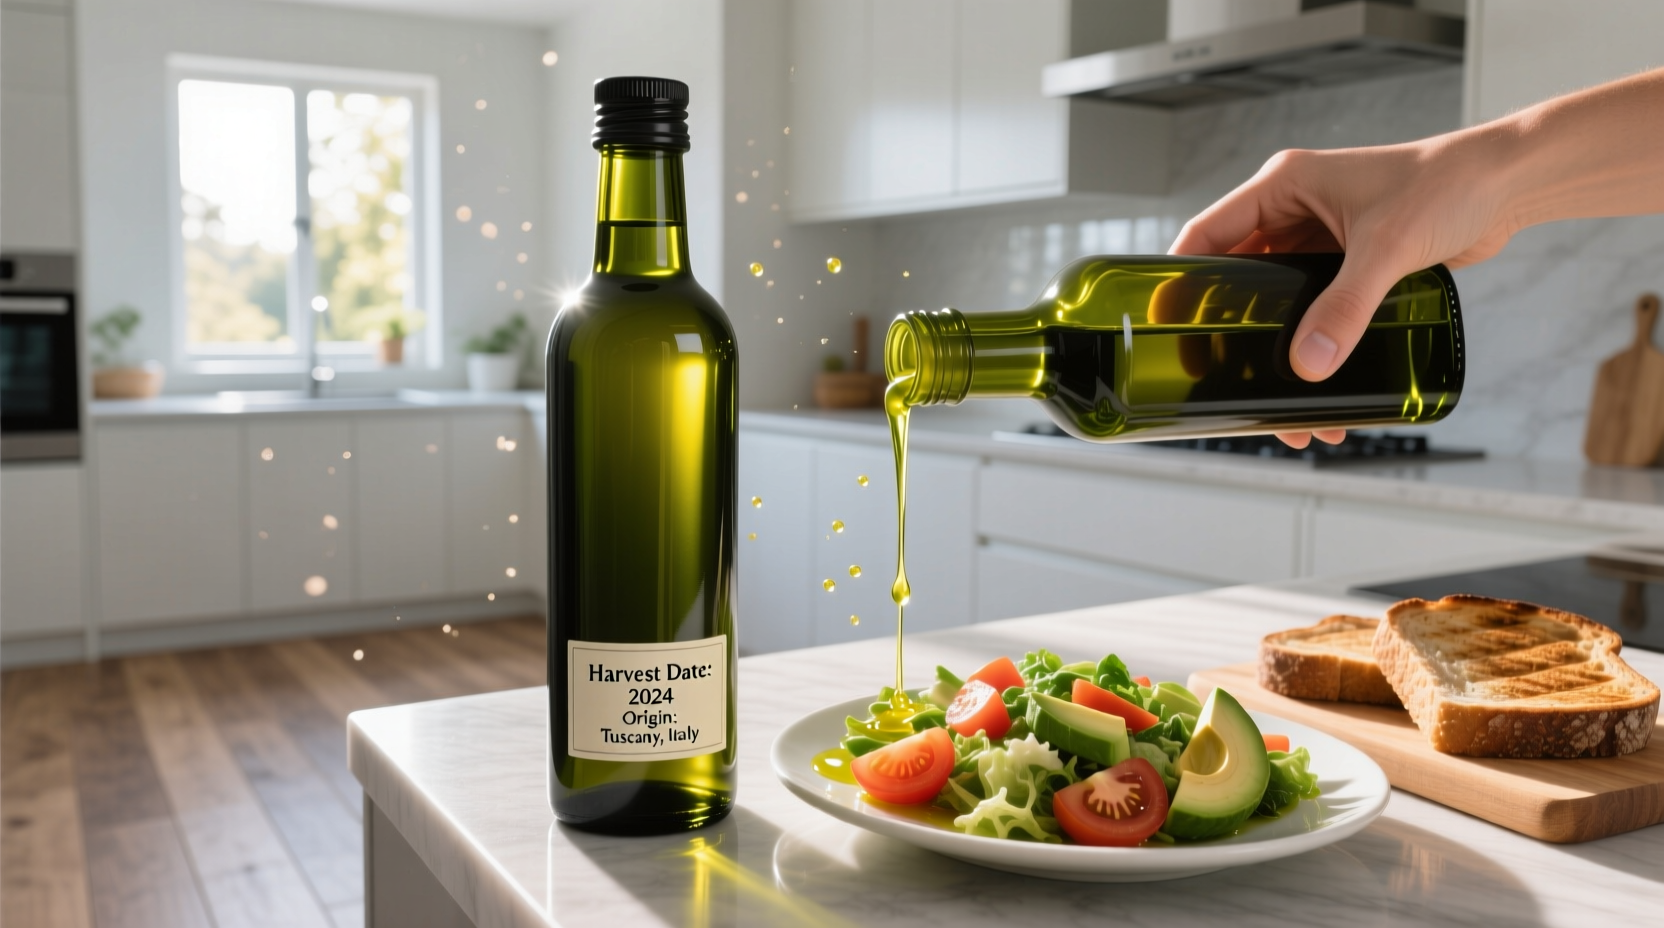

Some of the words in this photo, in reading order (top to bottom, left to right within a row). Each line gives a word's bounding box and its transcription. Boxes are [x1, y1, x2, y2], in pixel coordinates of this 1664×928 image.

[589, 664, 661, 682] Harvest
[667, 663, 712, 681] Date:
[628, 687, 675, 705] 2024
[622, 710, 678, 729] Origin:
[601, 728, 664, 747] Tuscany,
